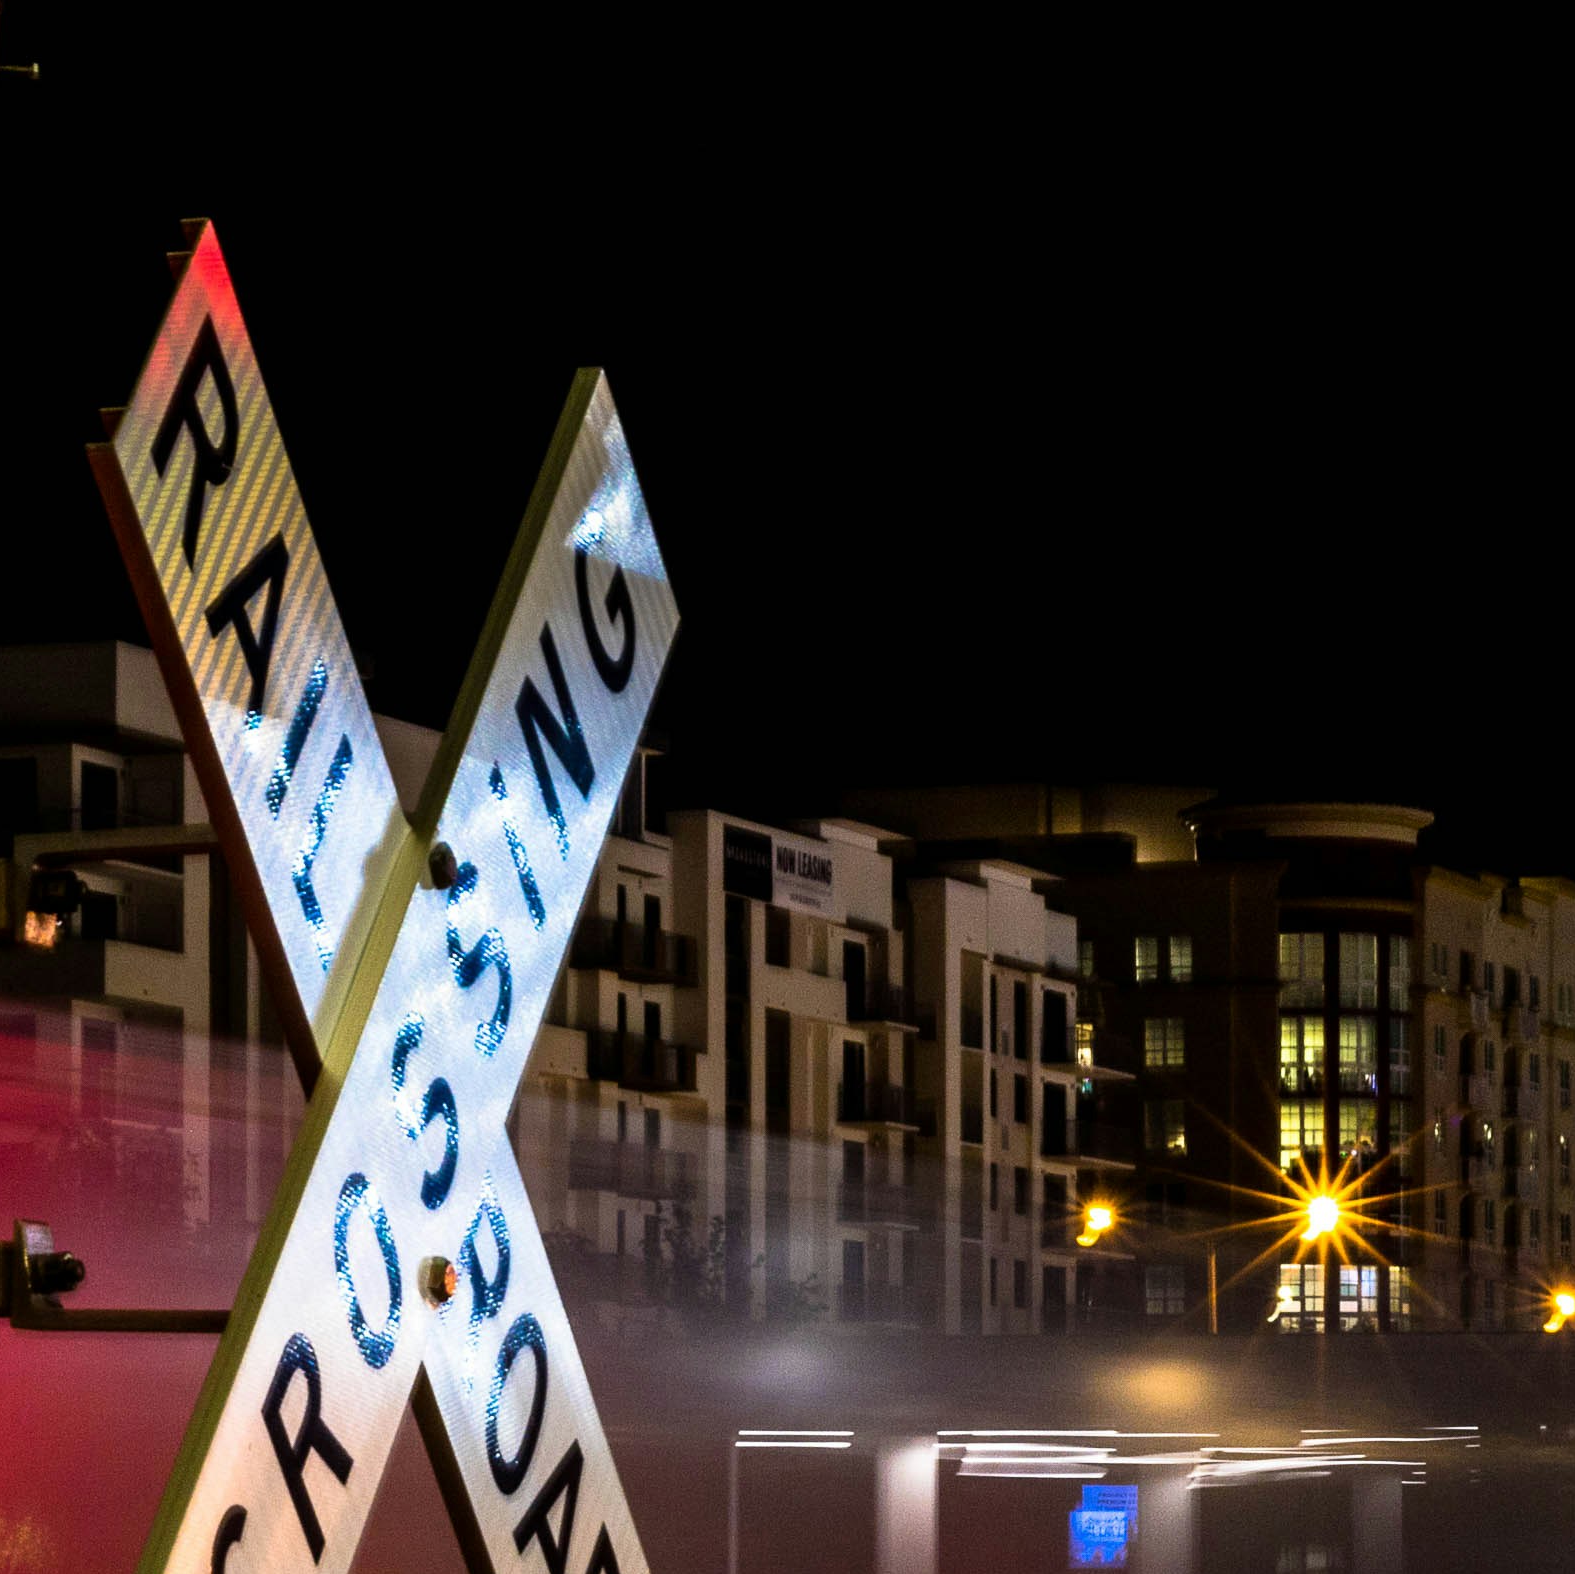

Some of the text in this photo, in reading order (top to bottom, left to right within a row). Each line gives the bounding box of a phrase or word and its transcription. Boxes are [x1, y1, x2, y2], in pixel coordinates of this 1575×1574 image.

[152, 312, 353, 971] RAIL
[777, 846, 796, 874] NOW
[798, 851, 832, 885] LEASING
